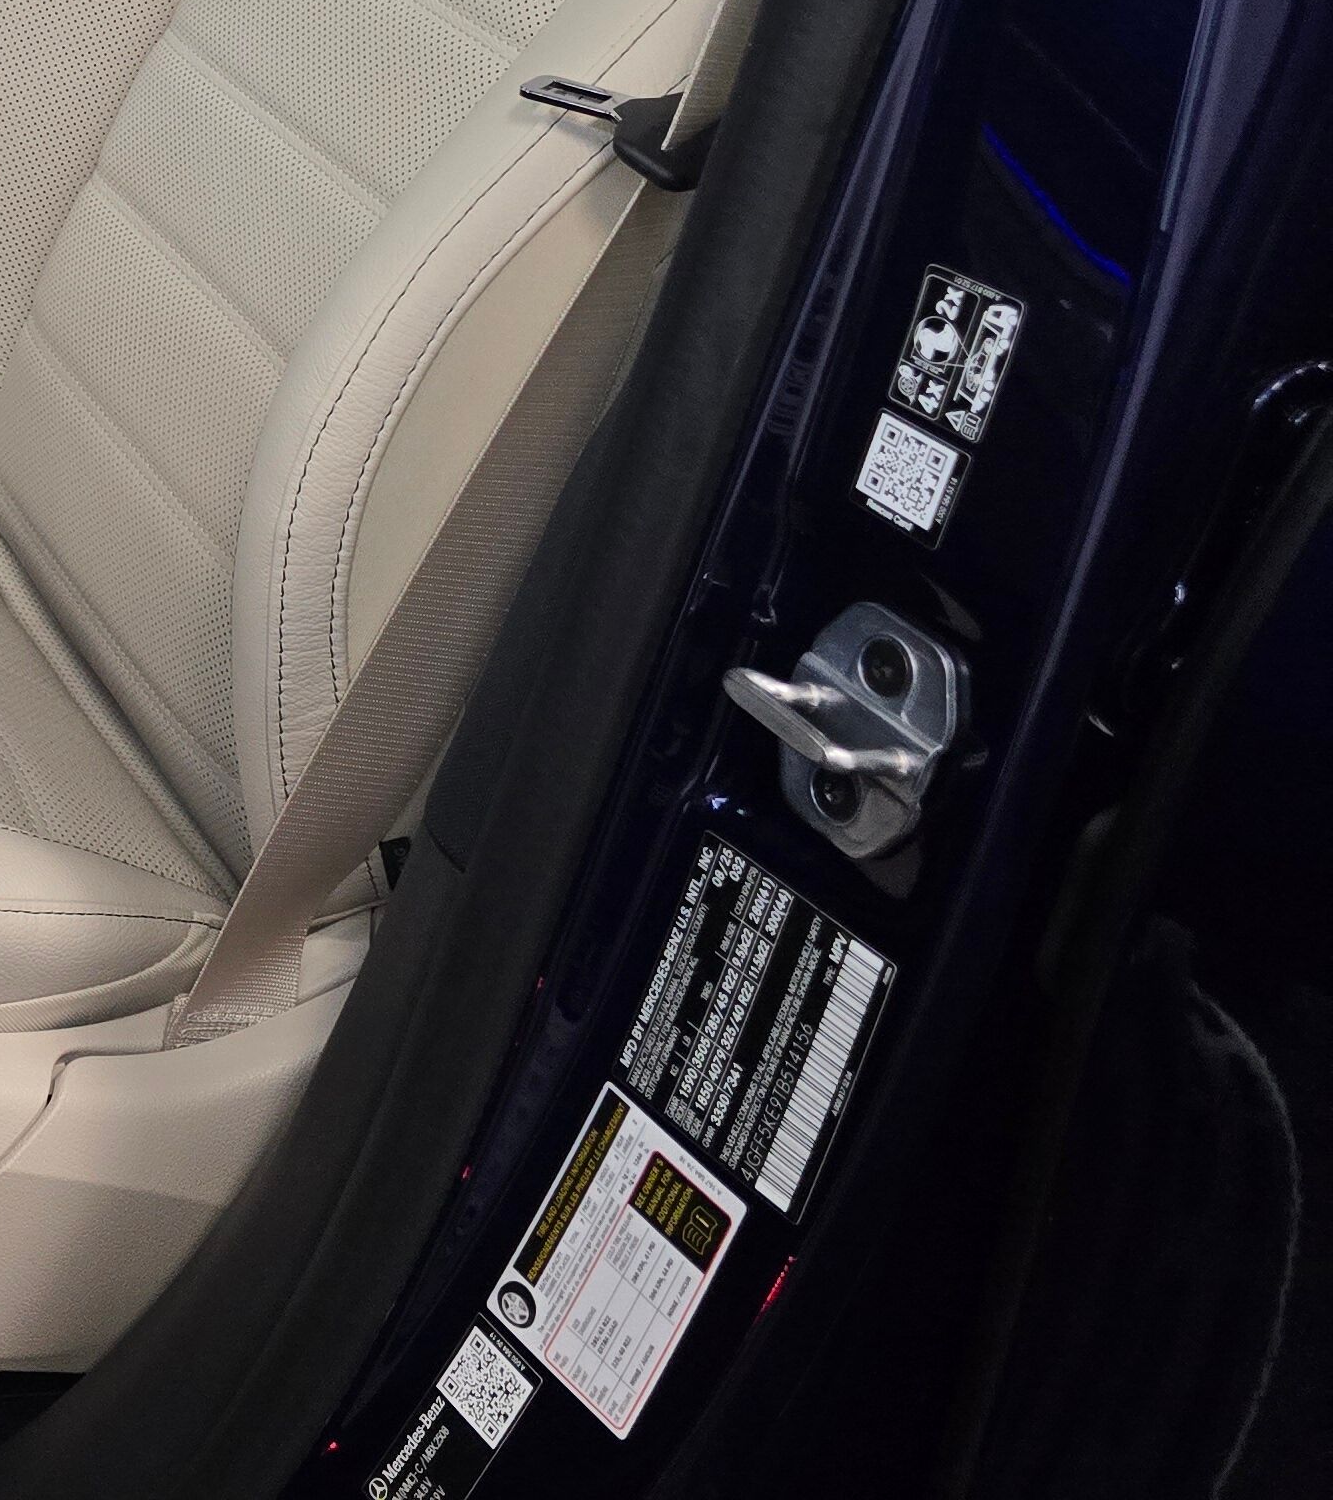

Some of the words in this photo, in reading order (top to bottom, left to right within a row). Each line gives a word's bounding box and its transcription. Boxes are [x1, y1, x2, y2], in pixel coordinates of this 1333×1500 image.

[696, 844, 714, 871] INC
[709, 845, 736, 889] 08/25
[727, 854, 746, 883] 032
[674, 902, 693, 930] U.S.
[763, 886, 794, 939] 300(44)
[806, 914, 823, 942] SAFETY
[827, 930, 849, 964] MPV
[636, 926, 684, 1024] MERCEDES-BENZ
[786, 965, 802, 994] MOTOR
[702, 989, 731, 1040] 285/45
[720, 966, 739, 994] R22
[719, 1002, 747, 1052] 325/40
[737, 979, 755, 1007] R22
[774, 990, 792, 1023] FEDERAL
[630, 1019, 645, 1041] BY
[619, 1036, 638, 1068] MFD
[628, 1031, 656, 1088] MANUFACTURED
[636, 1067, 651, 1094] UNDER
[646, 1033, 666, 1071] CONTRACT
[660, 1018, 672, 1036] FOR
[690, 1034, 712, 1070] 3505
[706, 1046, 727, 1083] 4079
[754, 1057, 766, 1073] ALL
[765, 1053, 779, 1075] DATE
[772, 1044, 782, 1057] OF
[677, 1065, 699, 1100] 1590
[722, 1060, 743, 1096] 7341
[751, 1069, 761, 1083] TO
[760, 1071, 772, 1087] THE
[694, 1078, 715, 1113] 1850
[709, 1091, 731, 1127] 3330
[738, 1018, 815, 1185] 4JGFF5KE9TB514156
[535, 1220, 548, 1239] TIRE
[543, 1204, 557, 1223] AND
[552, 1174, 574, 1208] LOADING
[569, 1127, 599, 1177] INFORMATION
[559, 1202, 572, 1221] SUR
[567, 1189, 579, 1206] LES
[591, 1148, 601, 1161] LE
[633, 1191, 646, 1209] SEE
[643, 1182, 665, 1217] MANUAL
[659, 1167, 673, 1186] FOR
[655, 1180, 682, 1225] ADDITIONAL
[663, 1185, 694, 1236] INFORMATION
[382, 1396, 446, 1484] Mercedes-Benz
